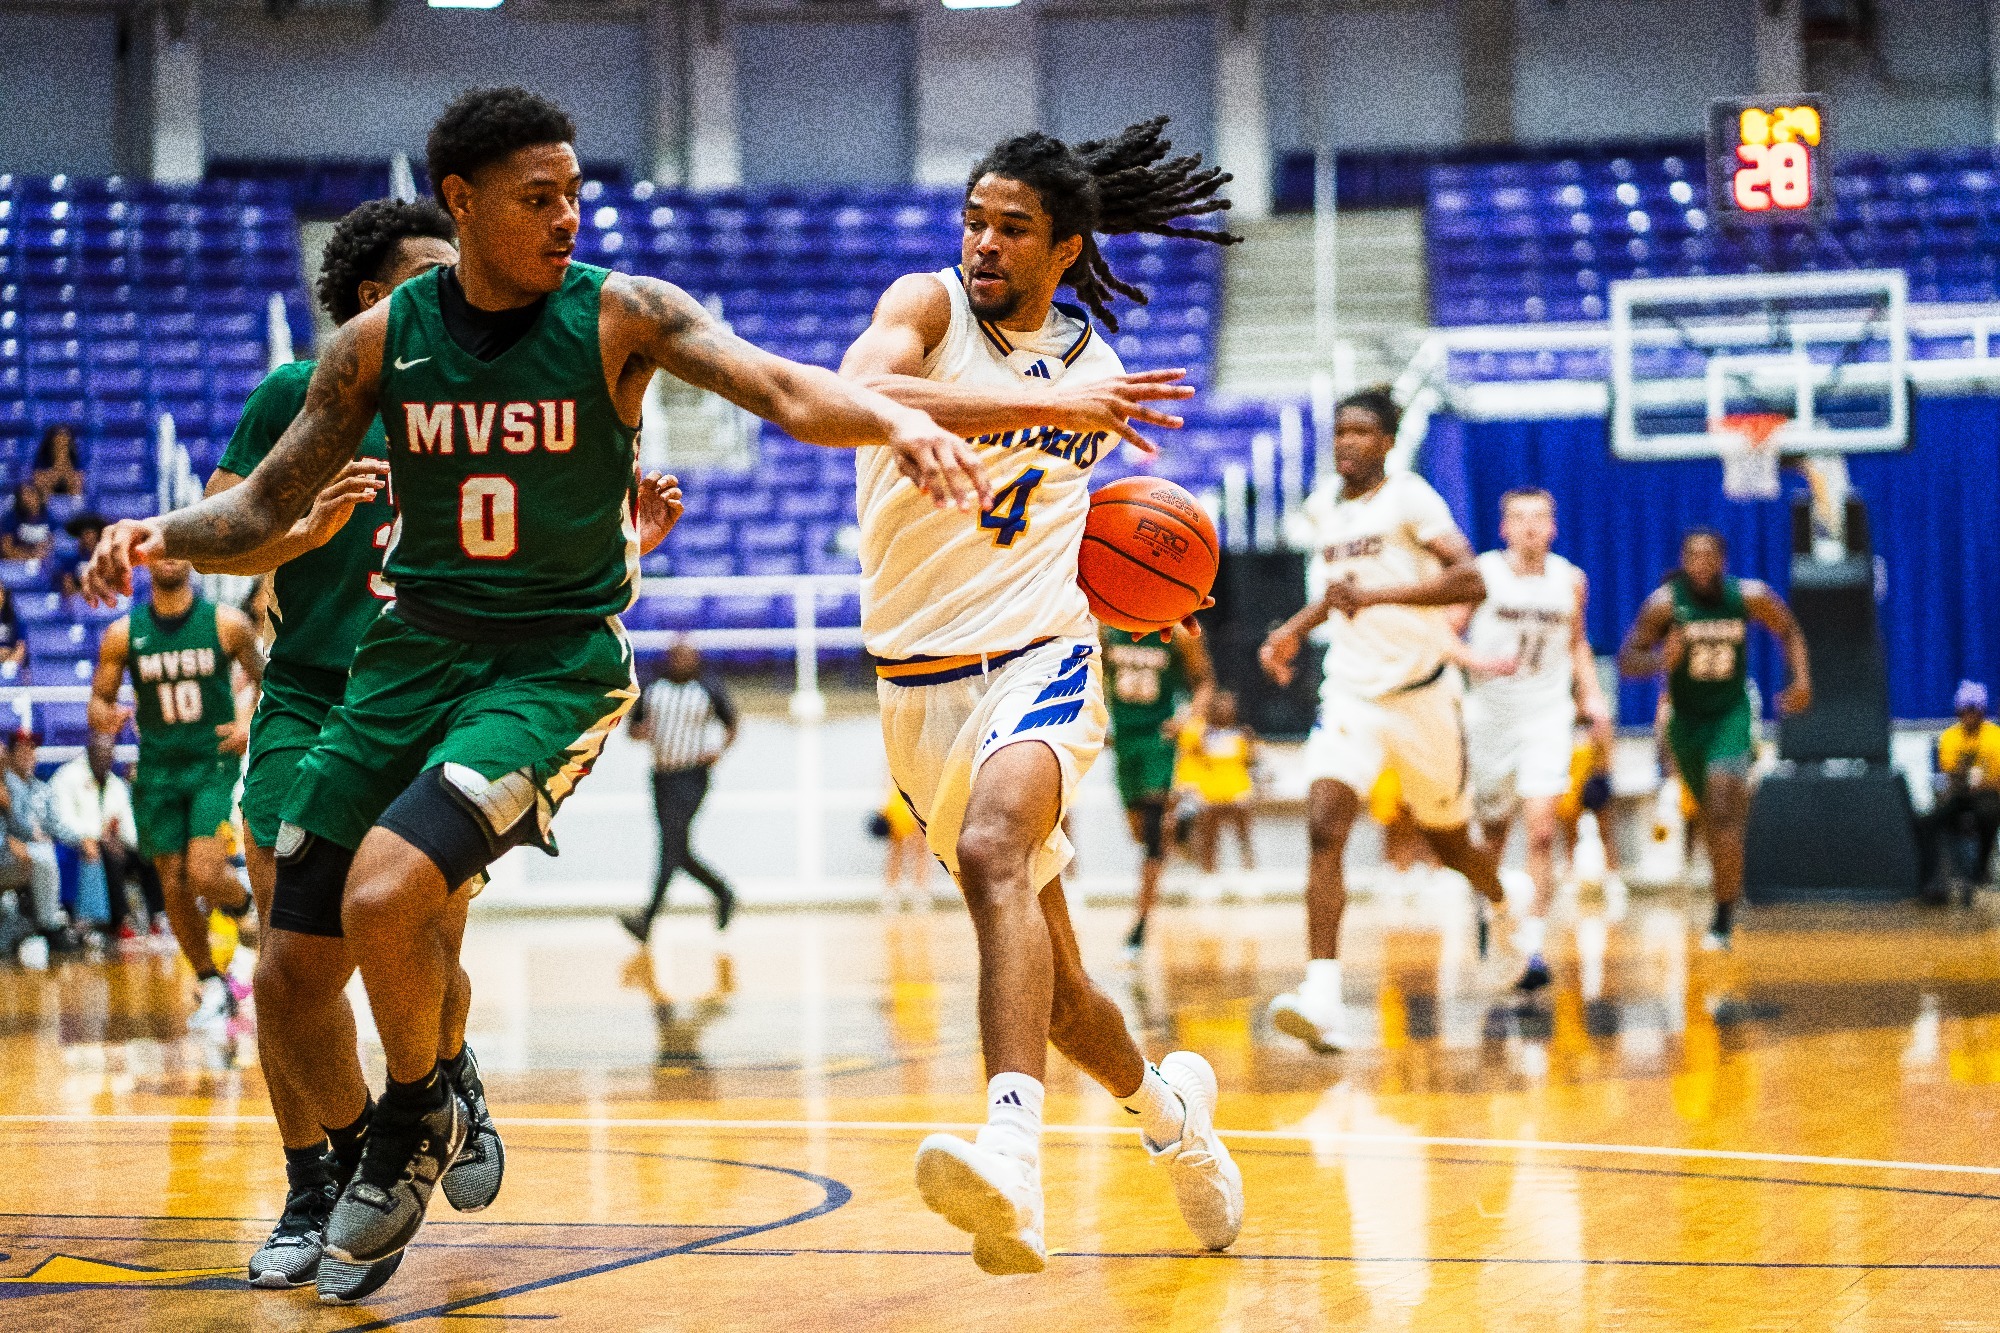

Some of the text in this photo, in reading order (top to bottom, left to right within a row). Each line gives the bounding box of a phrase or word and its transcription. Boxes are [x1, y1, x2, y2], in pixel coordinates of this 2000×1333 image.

[1734, 142, 1811, 211] 28
[402, 400, 577, 454] MVSU
[458, 473, 519, 560] 0
[978, 465, 1047, 548] 4
[1135, 517, 1190, 555] PRO
[157, 679, 203, 725] 10
